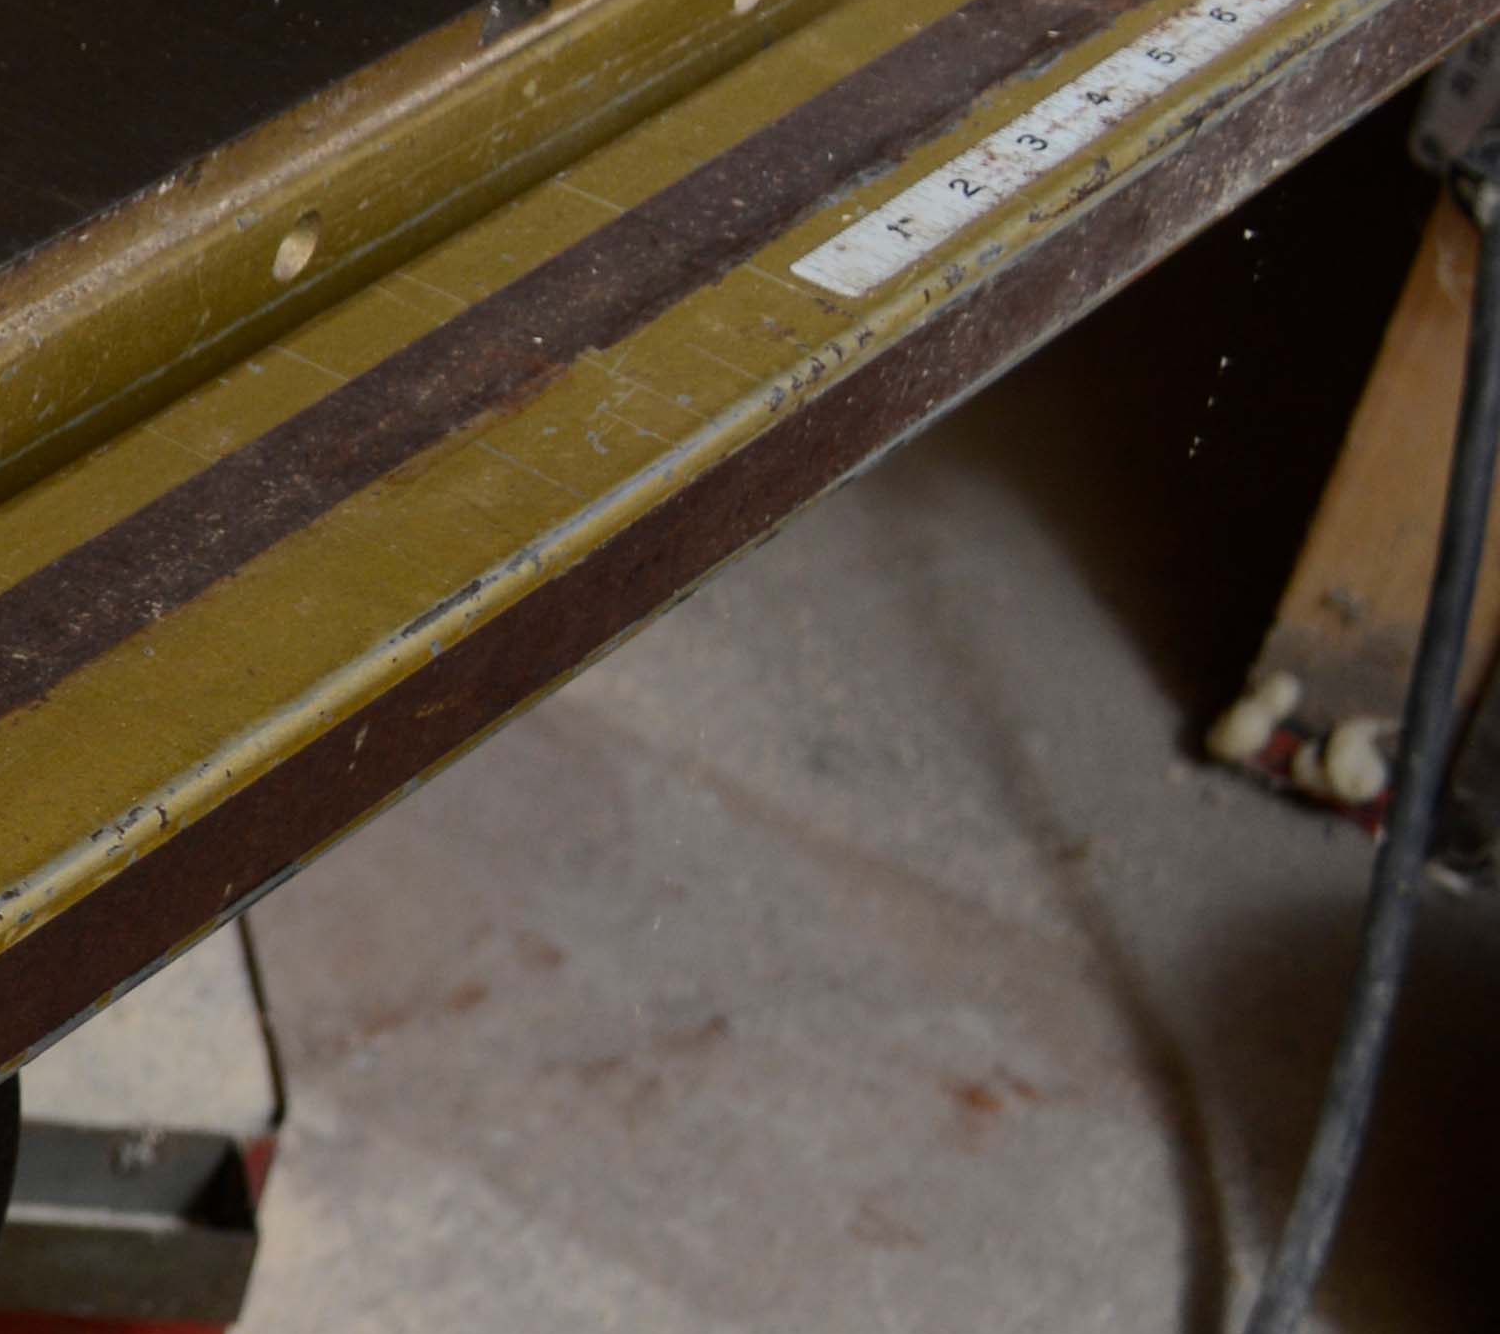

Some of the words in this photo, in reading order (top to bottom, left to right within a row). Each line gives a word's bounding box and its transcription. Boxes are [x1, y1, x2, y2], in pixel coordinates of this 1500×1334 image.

[949, 178, 987, 197] 2
[1017, 134, 1048, 151] 3
[1085, 91, 1111, 106] 4
[1146, 47, 1176, 64] 5
[1210, 8, 1237, 22] 6
